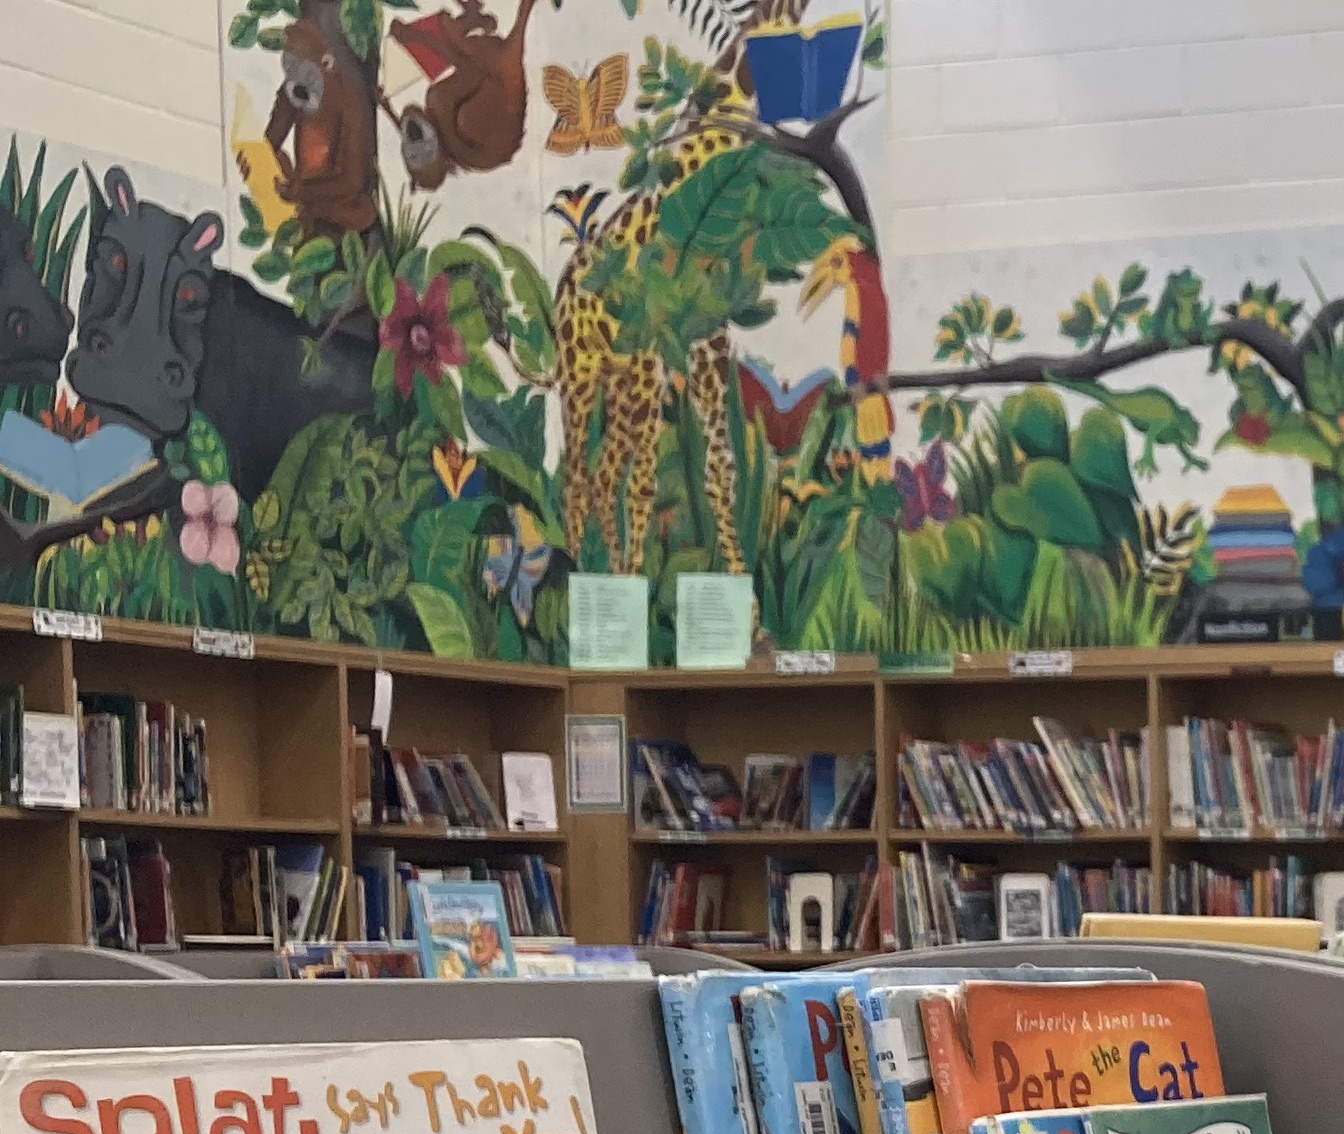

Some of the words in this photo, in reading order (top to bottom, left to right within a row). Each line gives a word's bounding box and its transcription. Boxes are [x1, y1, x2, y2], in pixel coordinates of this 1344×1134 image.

[1016, 1011, 1076, 1034] Kimberly
[409, 1059, 549, 1134] Thank
[993, 1040, 1092, 1114] Pete
[1091, 1044, 1122, 1077] the
[1129, 1041, 1205, 1104] Cat
